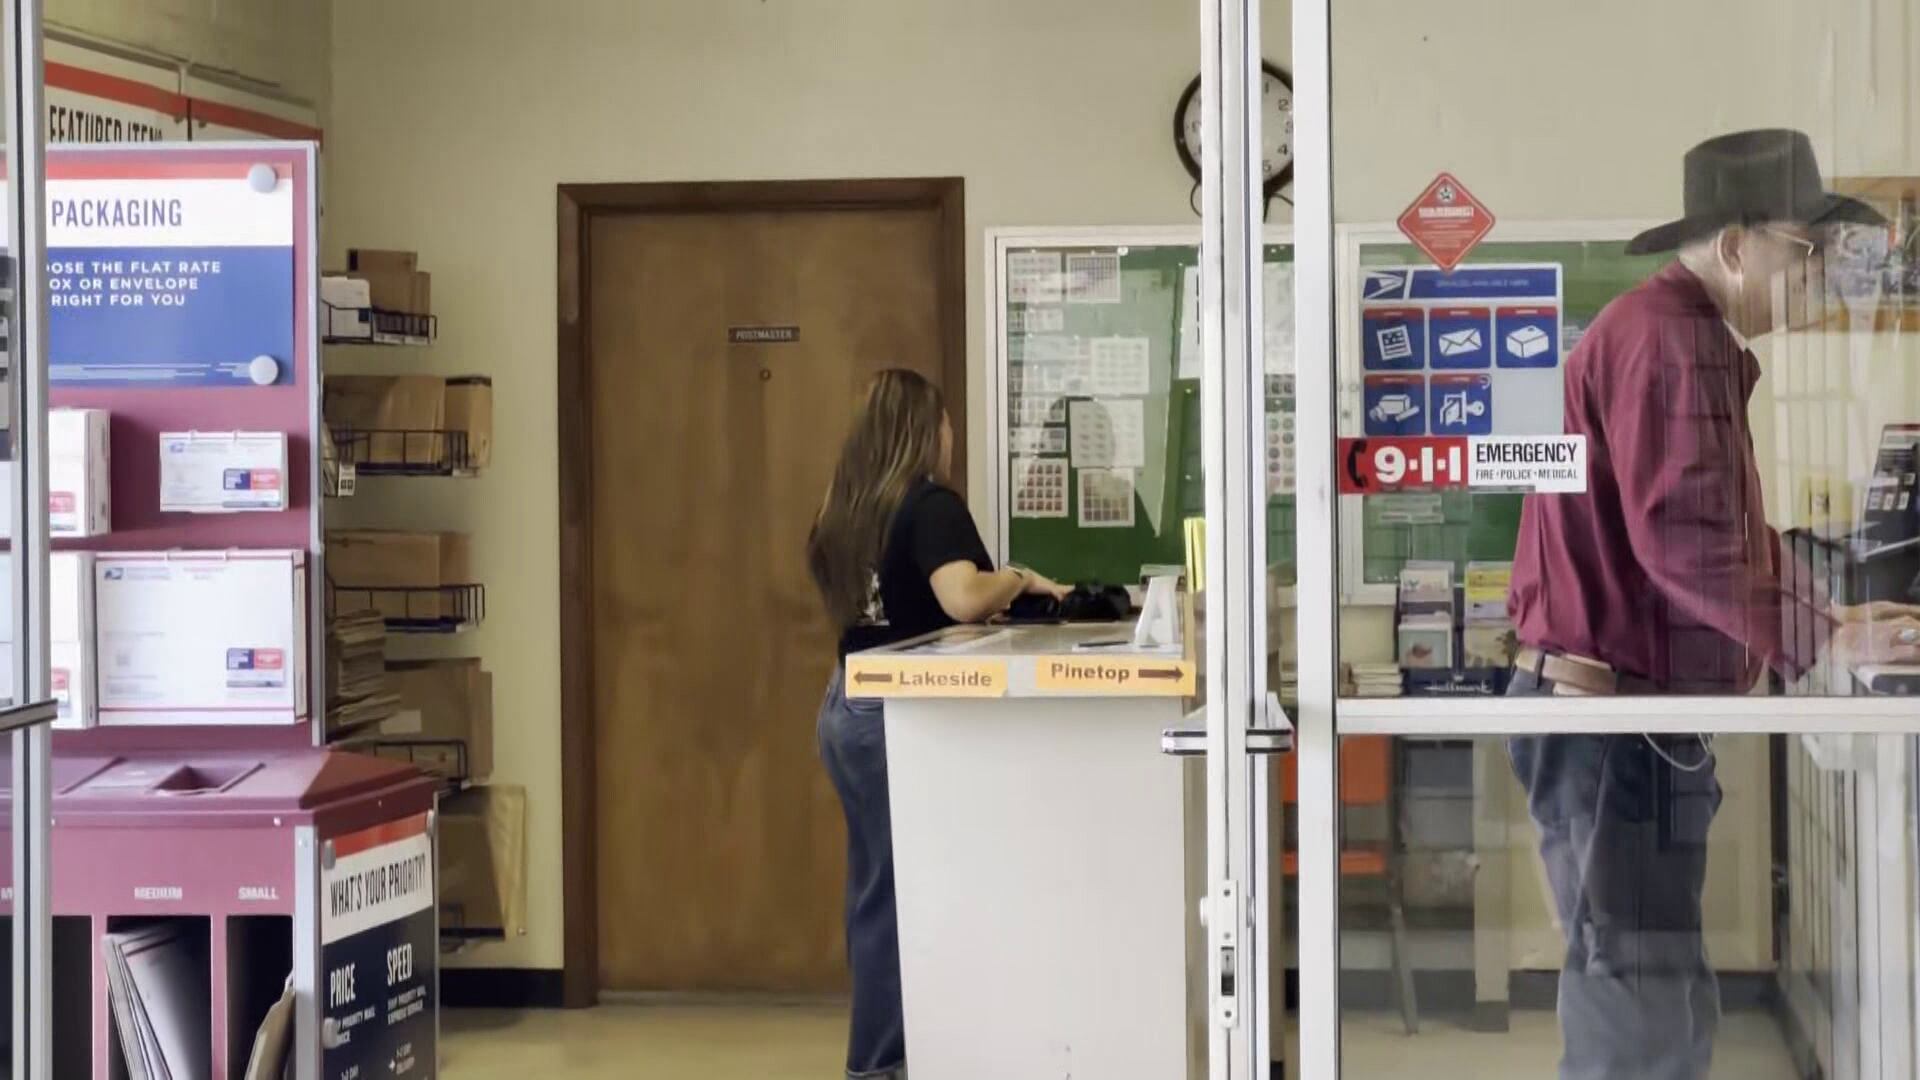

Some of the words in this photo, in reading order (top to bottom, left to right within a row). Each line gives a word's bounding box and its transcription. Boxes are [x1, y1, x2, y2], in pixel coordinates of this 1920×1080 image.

[51, 199, 183, 227] PACKAGING
[46, 261, 84, 274] OSE
[92, 261, 124, 274] THE
[131, 261, 171, 273] FLAT
[179, 260, 221, 273] RATE
[49, 277, 72, 290] OX
[79, 277, 103, 290] OR
[110, 277, 198, 290] ENVELOPE
[52, 293, 102, 306] RIGHT
[110, 293, 143, 306] FOR
[152, 293, 185, 306] YOU
[1476, 442, 1577, 463] EMERGENCY
[1475, 468, 1495, 480] FIRE
[1501, 468, 1531, 480] POLICE
[1538, 468, 1578, 480] MEDICAL
[899, 670, 993, 687] Lakeside
[1051, 662, 1130, 683] Pinetop
[238, 887, 279, 900] SMALL
[330, 872, 362, 918] WHAT'S
[364, 865, 387, 908] YOUR
[386, 943, 413, 987] SPEED
[330, 962, 356, 1009] PRICE
